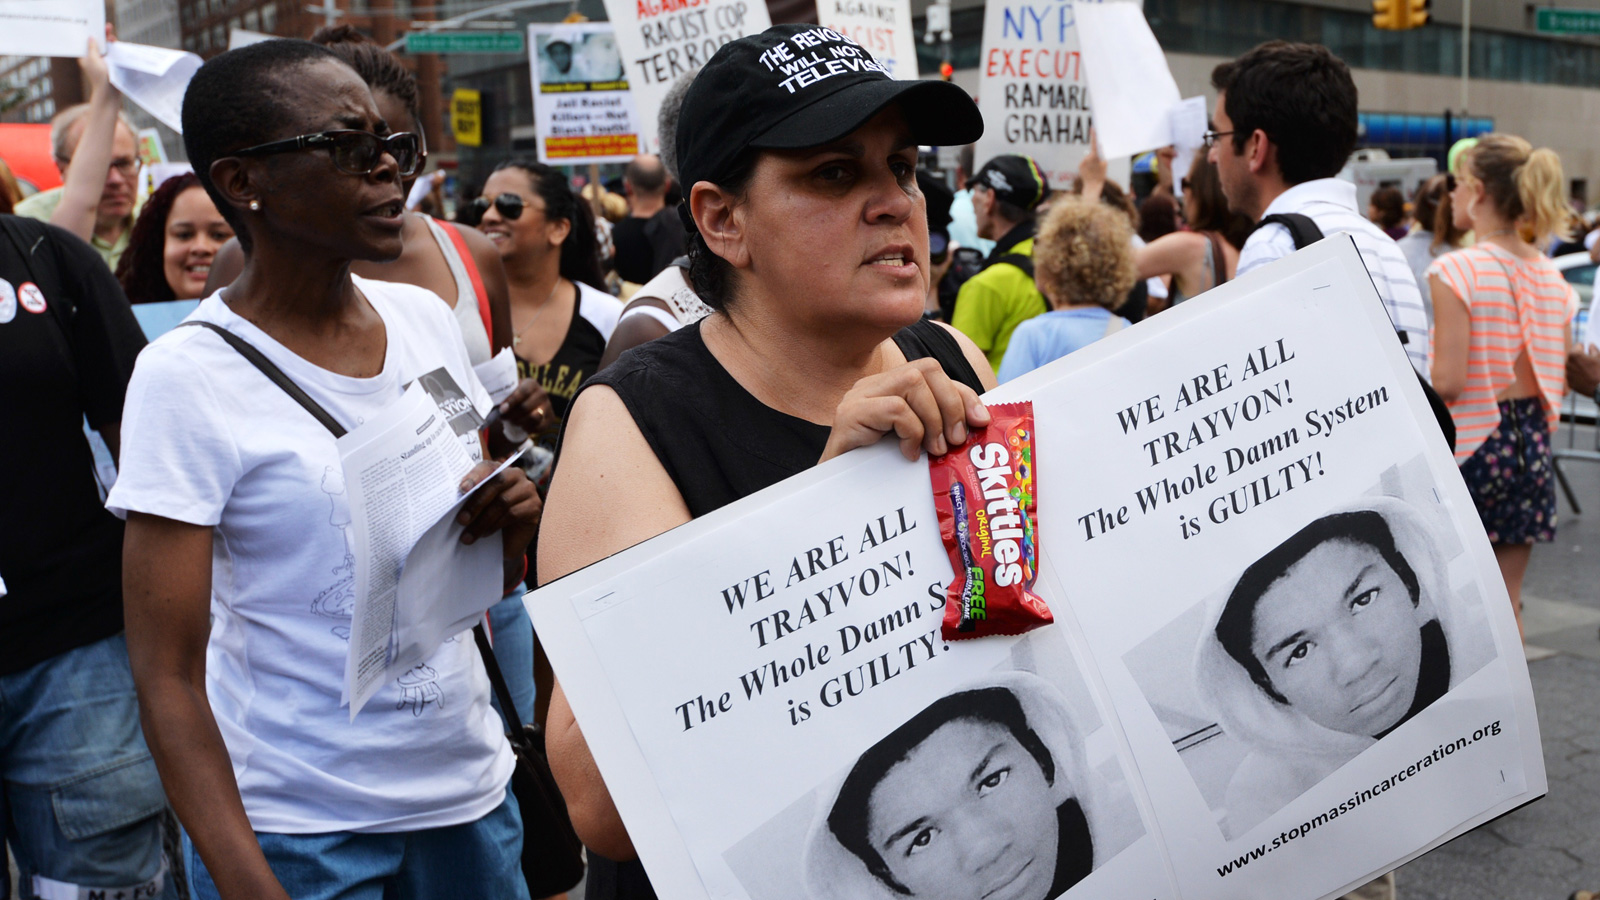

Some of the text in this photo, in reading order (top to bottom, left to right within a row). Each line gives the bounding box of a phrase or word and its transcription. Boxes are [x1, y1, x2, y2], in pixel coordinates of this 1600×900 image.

[641, 1, 748, 48] RACIST COP
[1003, 4, 1075, 43] NYP
[758, 42, 795, 72] THE
[778, 45, 863, 77] WILL NOT
[986, 48, 1080, 81] EXECUT
[1005, 83, 1090, 111] RAMARL
[1115, 338, 1295, 435] WE ARE ALL
[1143, 379, 1294, 467] TRAYVON!
[1077, 385, 1390, 542] The Whole Damn System
[953, 485, 963, 510] KINECT
[970, 442, 1024, 587] Skittles
[1179, 451, 1325, 540] is GUILTY!
[720, 506, 917, 615] WE ARE ALL
[750, 550, 915, 649] TRAYVON!
[963, 597, 971, 620] GAME
[970, 567, 986, 620] FREE
[675, 600, 922, 732] The Whole Damn
[787, 699, 812, 726] is
[1216, 720, 1502, 878] www.stopmassincarceration.org
